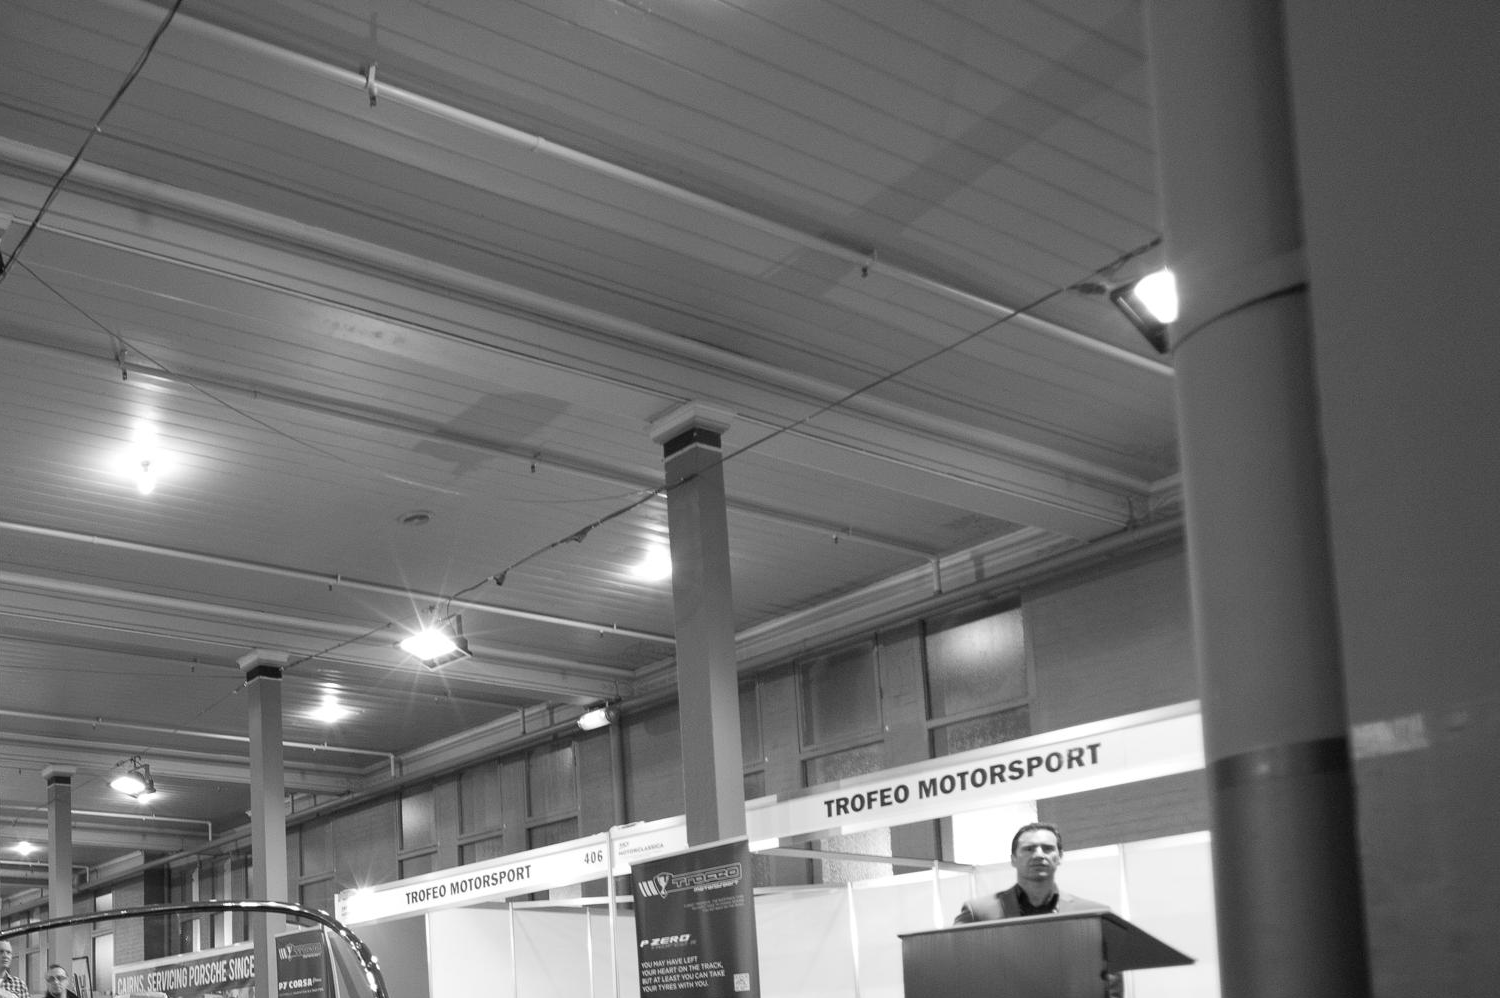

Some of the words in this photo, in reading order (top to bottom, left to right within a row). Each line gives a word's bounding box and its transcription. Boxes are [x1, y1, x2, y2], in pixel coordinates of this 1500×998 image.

[824, 784, 910, 818] TROFEO
[917, 742, 1101, 800] MOTORSPORT
[584, 850, 603, 864] 406
[405, 884, 447, 905] TROFEO
[450, 865, 532, 895] MOTORSPORT
[641, 961, 652, 969] YOU
[666, 957, 682, 966] HAVE
[683, 955, 698, 964] LEFT
[147, 967, 187, 992] SERVICING
[189, 960, 227, 987] PORSCHE
[229, 955, 256, 981] SINCE
[641, 969, 657, 977] YOUR
[657, 966, 677, 975] HEART
[642, 977, 653, 985] BUT
[653, 976, 661, 984] AT
[661, 974, 681, 983] LEAST
[681, 973, 694, 981] YOU
[695, 971, 708, 979] CAN
[709, 969, 725, 978] TAKE
[288, 978, 313, 989] CORSA
[642, 985, 658, 993] YOUR
[658, 983, 677, 991] TYRES
[678, 981, 694, 989] WITH
